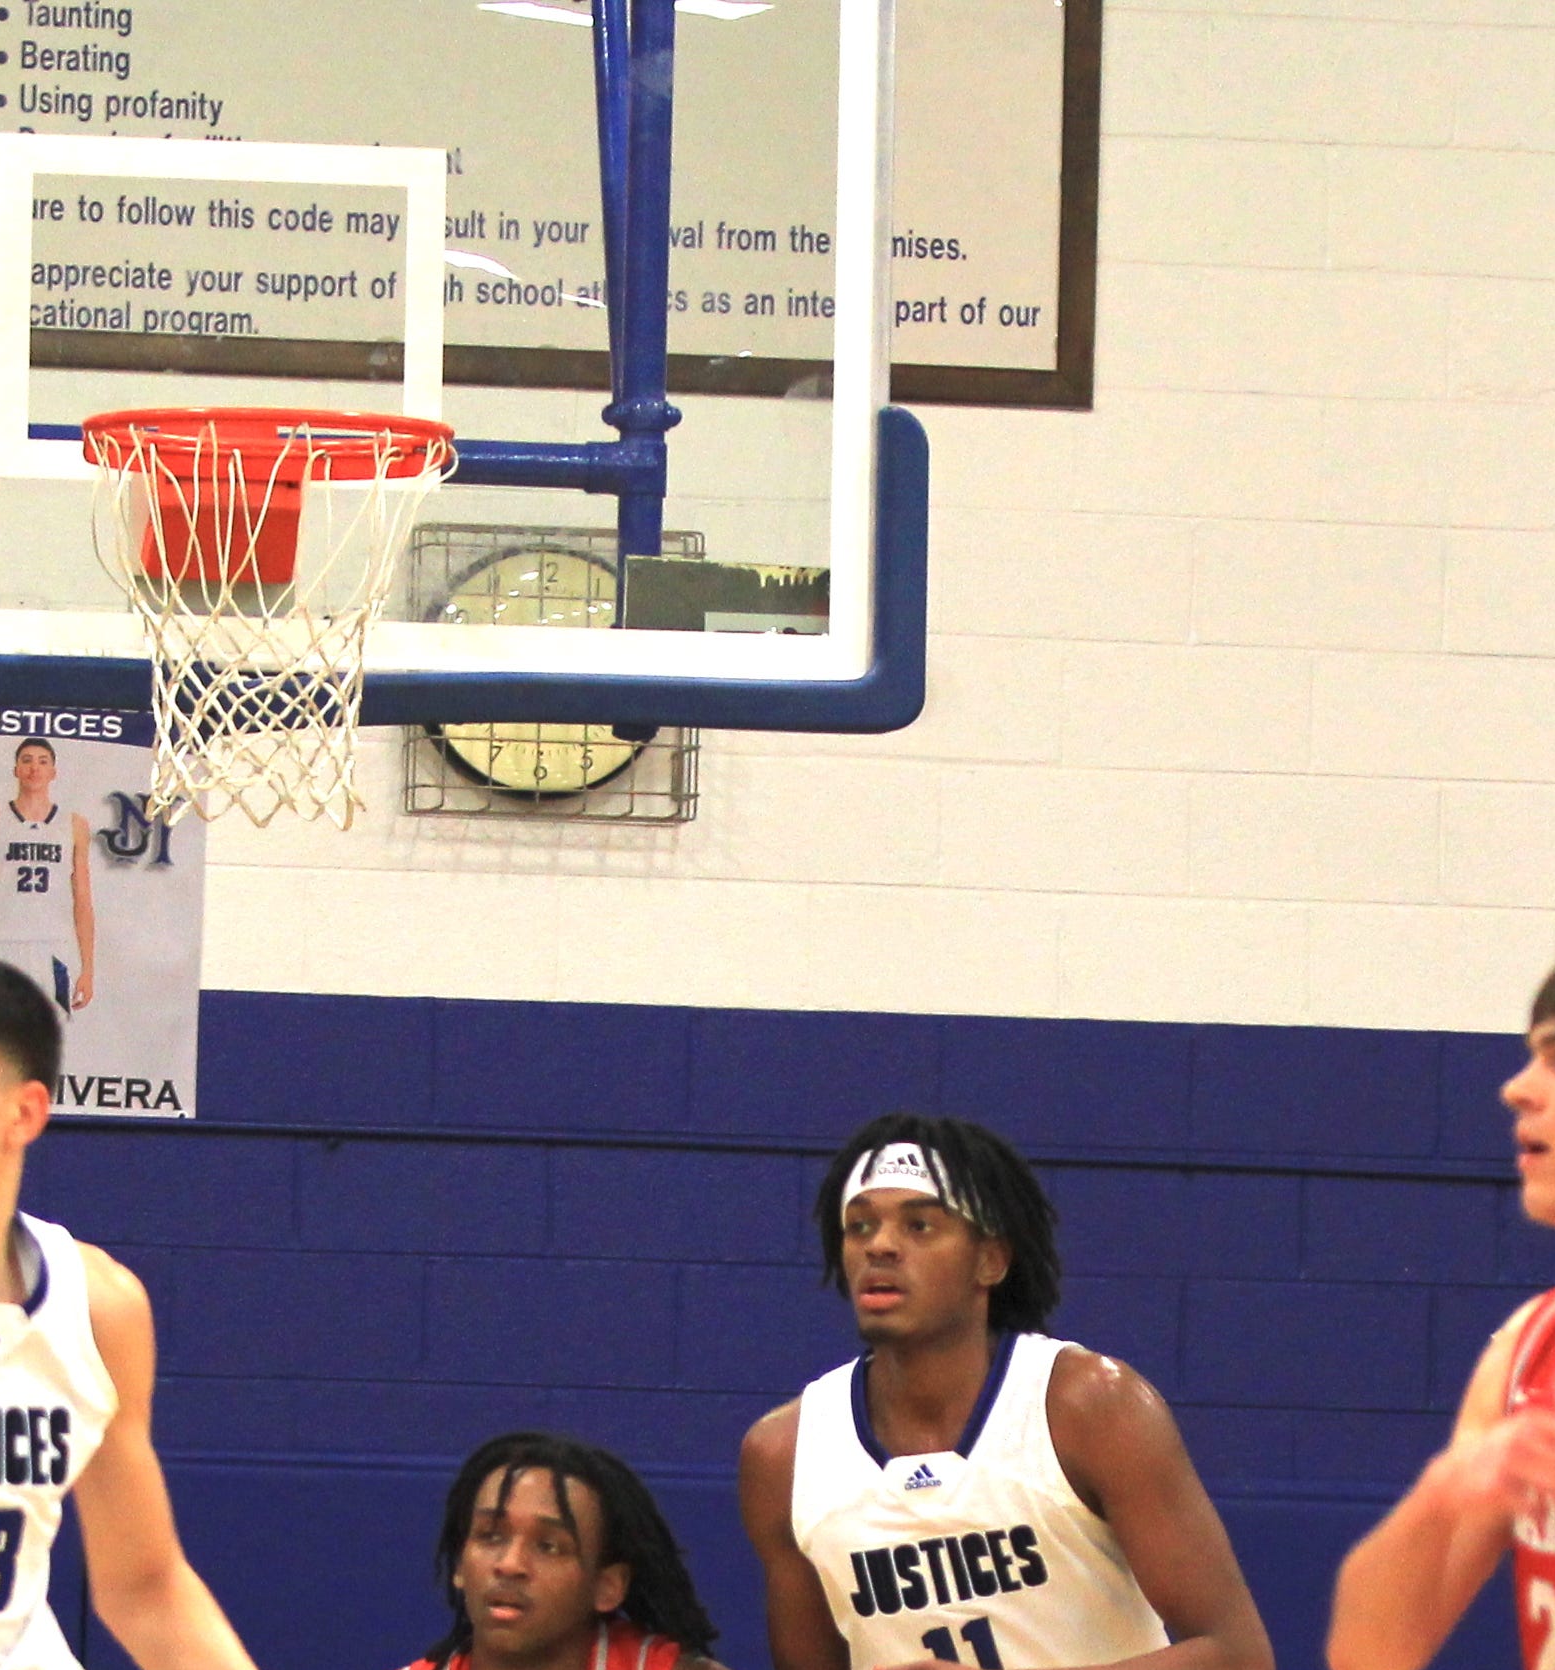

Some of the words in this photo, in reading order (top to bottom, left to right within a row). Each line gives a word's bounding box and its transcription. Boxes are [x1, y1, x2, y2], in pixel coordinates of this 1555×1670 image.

[23, 0, 132, 37] Taunting
[20, 40, 131, 80] Berating
[19, 84, 93, 122] Using
[105, 89, 224, 127] profanity
[78, 195, 104, 222] to
[117, 195, 195, 227] follow
[208, 200, 255, 229] this
[268, 203, 333, 233] code
[346, 211, 400, 241] may
[445, 210, 486, 240] sult
[499, 212, 520, 240] in
[533, 220, 590, 248] your
[717, 221, 776, 252] from
[790, 224, 831, 254] the
[31, 260, 173, 292] appreciate
[186, 269, 244, 298] your
[256, 270, 358, 302] support
[371, 271, 397, 300] of
[476, 275, 563, 307] school
[701, 290, 731, 314] as
[744, 292, 776, 317] an
[895, 296, 948, 328] part
[960, 296, 987, 325] of
[999, 302, 1042, 328] our
[144, 308, 259, 335] program.
[5, 841, 63, 864] JUSTICES
[16, 866, 50, 893] 23
[53, 1074, 183, 1111] IVERA
[848, 1523, 1049, 1619] JUSTICES
